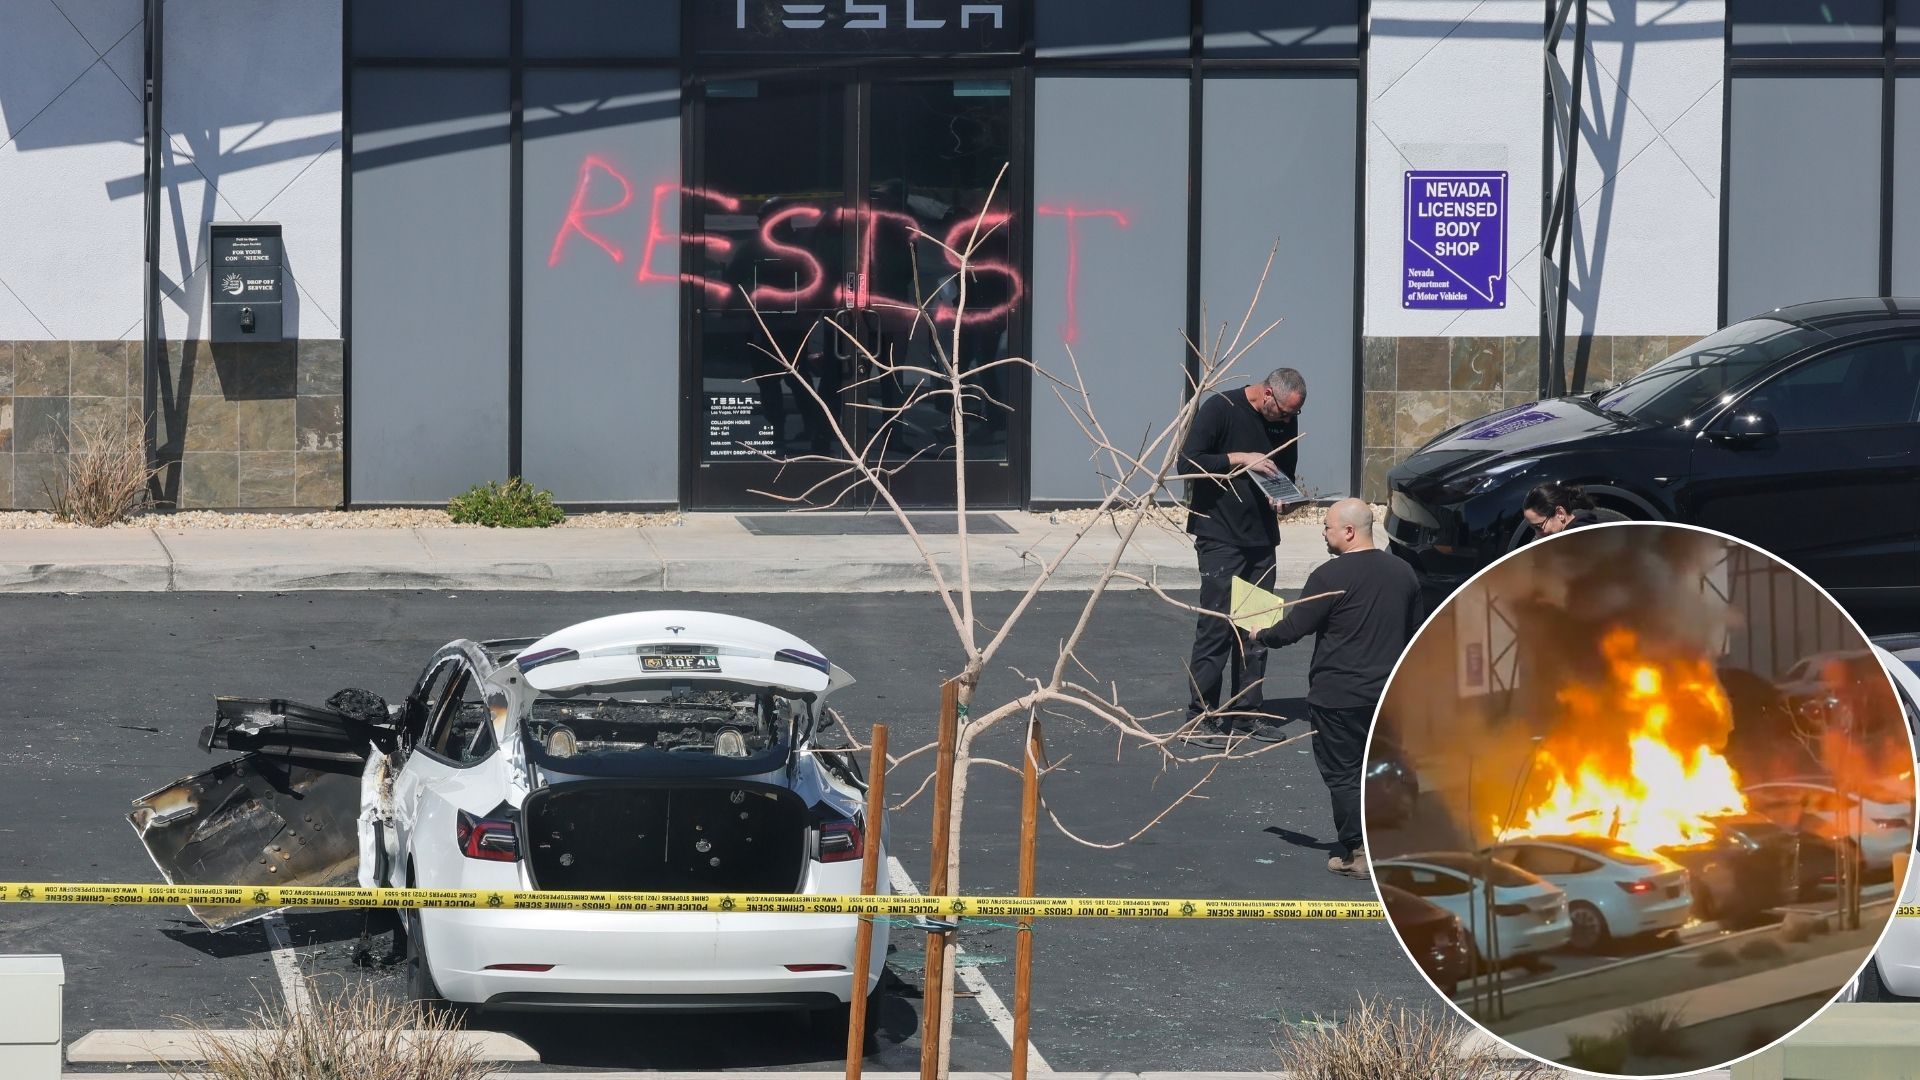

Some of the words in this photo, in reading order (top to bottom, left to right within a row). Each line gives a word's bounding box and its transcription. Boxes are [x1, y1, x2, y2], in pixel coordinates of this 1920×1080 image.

[1426, 182, 1491, 198] NEVADA
[1418, 202, 1498, 217] LICENSED
[1435, 222, 1481, 237] BODY
[548, 154, 1130, 345] RESIST
[1435, 242, 1480, 257] SHOP
[1408, 268, 1434, 277] Nevada
[1408, 280, 1450, 289] Department
[1408, 292, 1416, 300] of
[1417, 292, 1438, 300] Motor
[1440, 292, 1468, 300] Vehicles
[777, 904, 804, 913] CRIME
[813, 905, 842, 913] CROSS
[846, 905, 863, 913] NOT
[908, 906, 938, 914] POLICE
[977, 907, 1004, 915] SCENE
